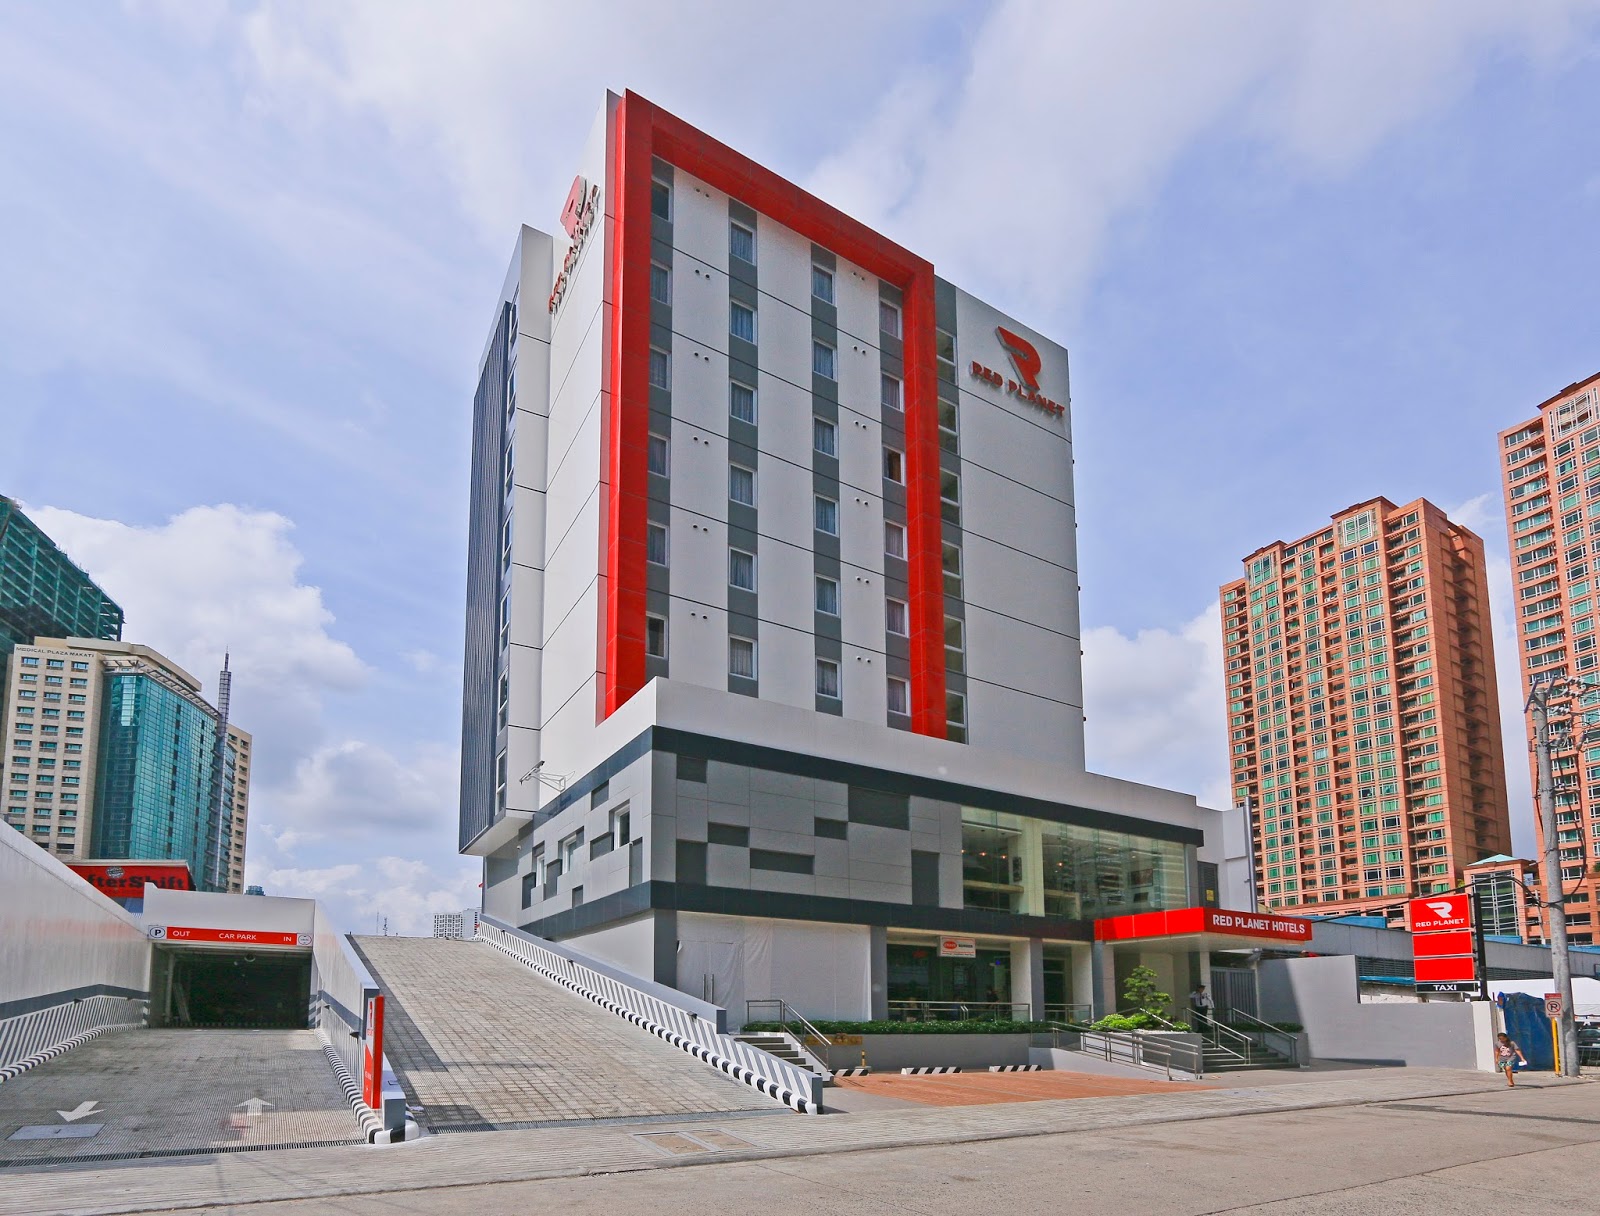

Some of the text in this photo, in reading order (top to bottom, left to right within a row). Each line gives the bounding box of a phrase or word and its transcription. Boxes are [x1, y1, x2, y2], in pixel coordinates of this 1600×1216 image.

[970, 360, 1065, 417] RED PLANET
[16, 646, 45, 654] MEDICAL
[85, 874, 184, 889] fterShift
[1212, 914, 1305, 934] RED PLANET HOTELS
[1433, 918, 1465, 926] PLANET
